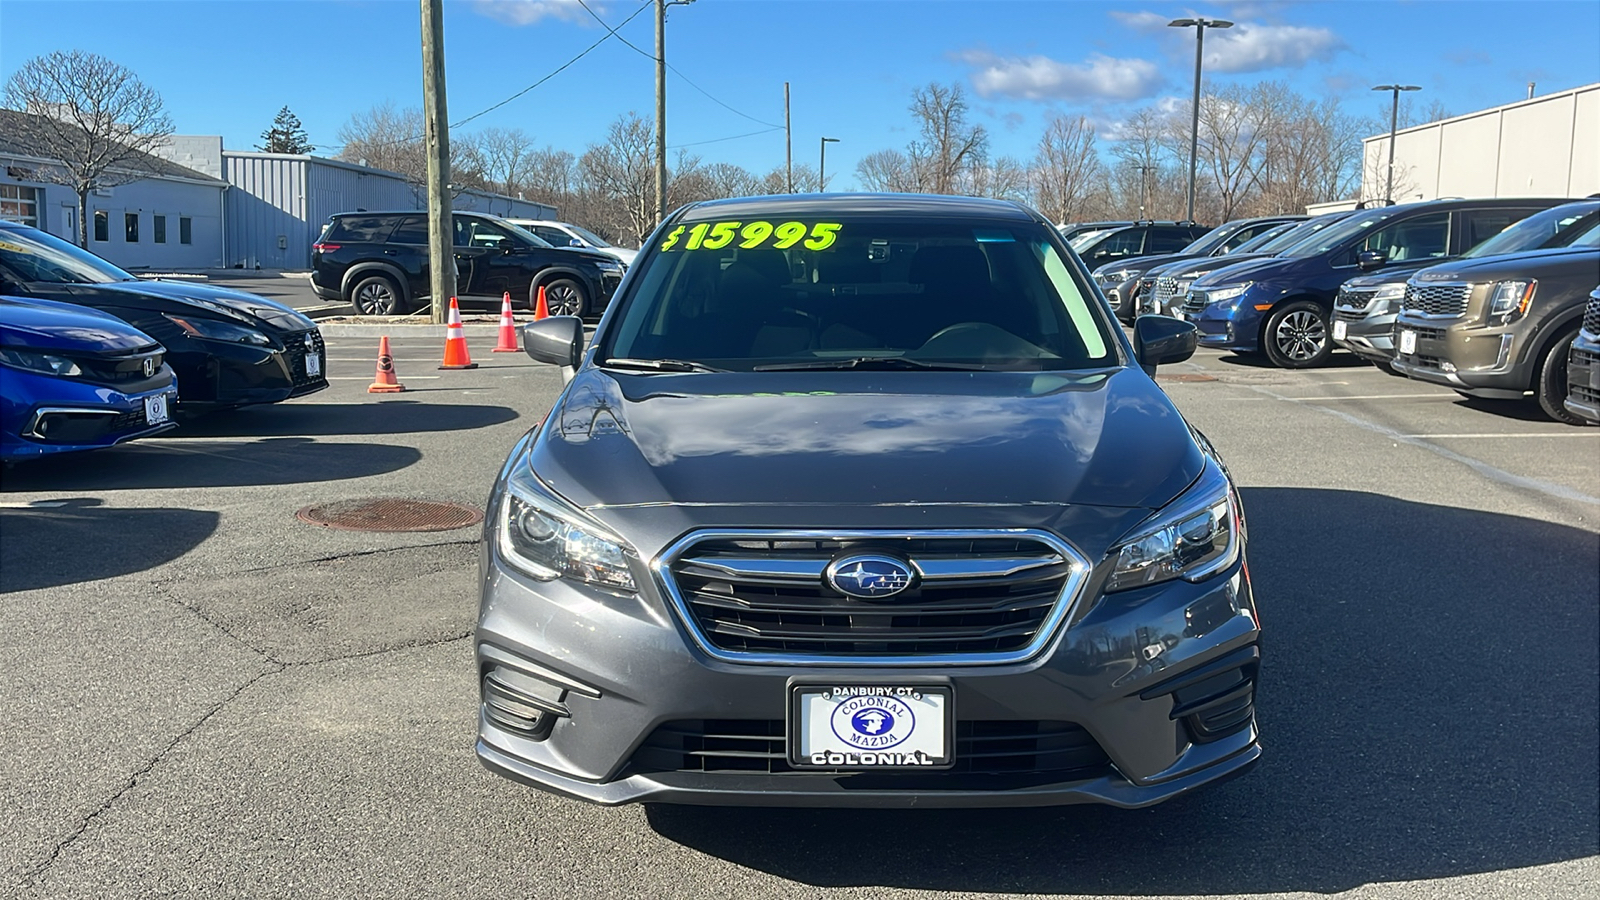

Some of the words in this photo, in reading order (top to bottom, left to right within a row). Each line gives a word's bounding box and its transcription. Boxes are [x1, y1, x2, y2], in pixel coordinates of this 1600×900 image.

[661, 221, 843, 252] $15995
[833, 687, 893, 697] DANBURY,
[897, 687, 914, 696] CT
[841, 697, 905, 718] COLONIAL
[849, 733, 898, 747] MAZDA
[811, 752, 933, 765] COLONIAL
